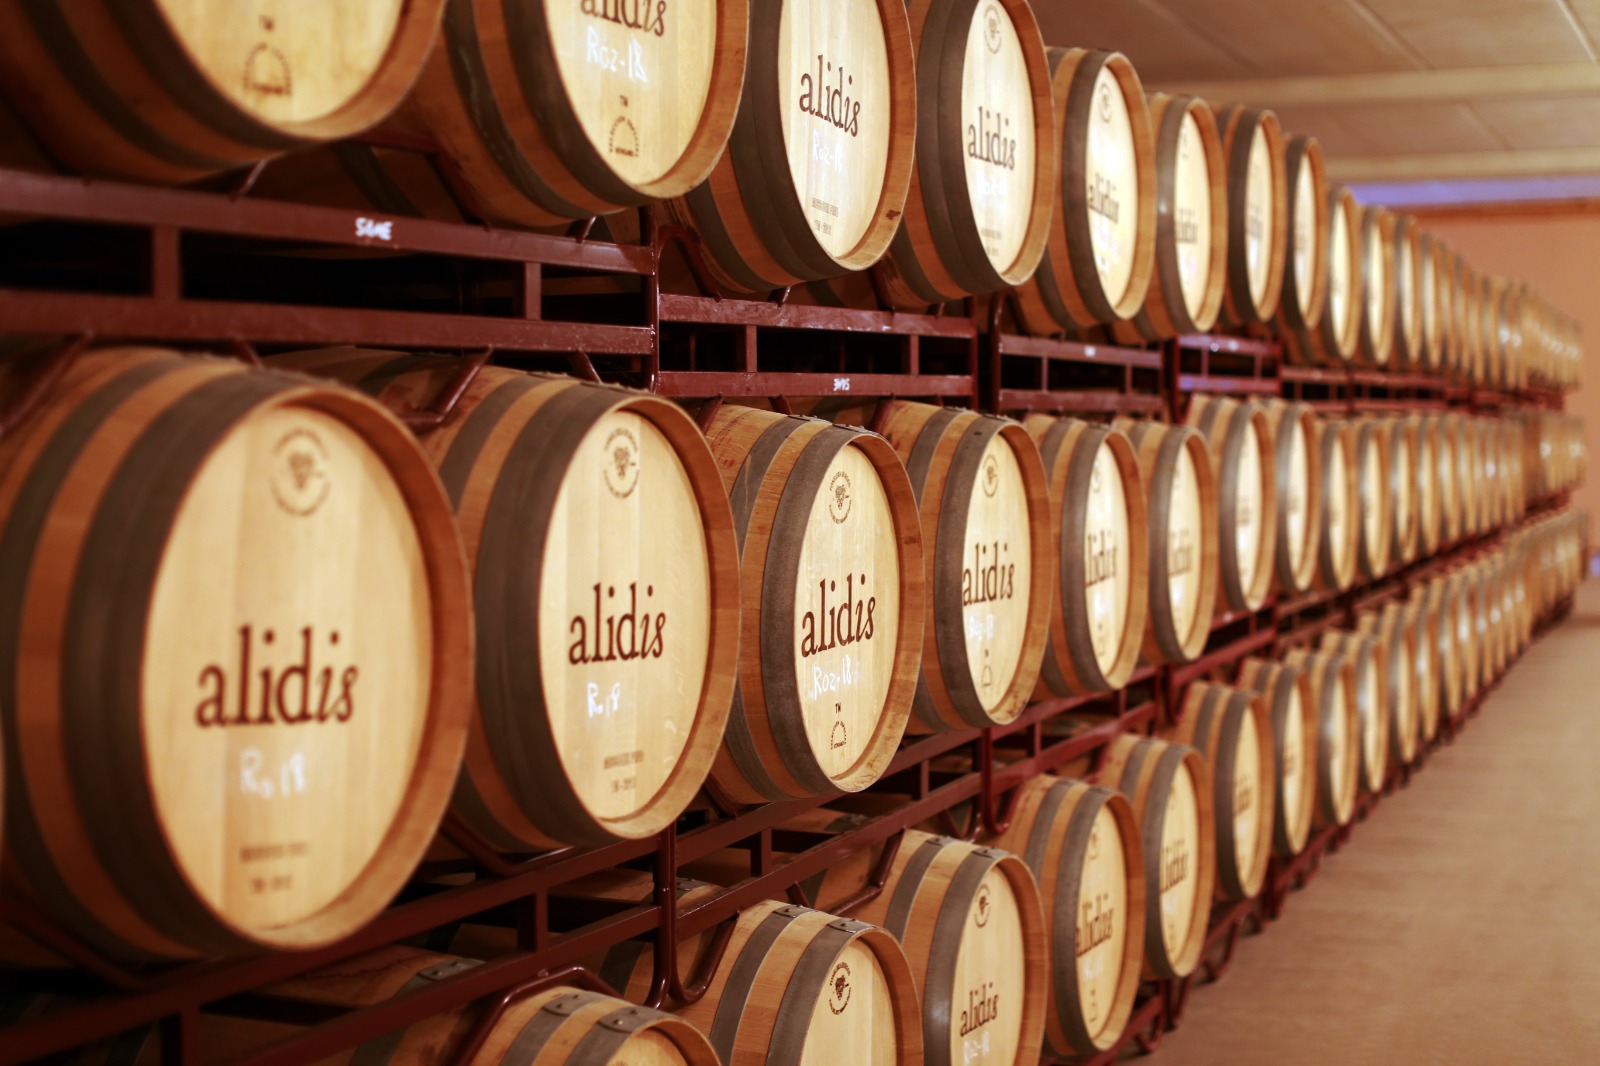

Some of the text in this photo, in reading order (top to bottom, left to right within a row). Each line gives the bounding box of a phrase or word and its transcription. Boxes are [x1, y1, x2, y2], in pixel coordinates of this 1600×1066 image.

[799, 54, 861, 138] alidis
[968, 106, 1016, 170] alidis
[801, 573, 876, 657] alidis
[963, 541, 1015, 606] alidis
[568, 582, 666, 665] alidis
[195, 623, 359, 727] alidis
[960, 982, 999, 1037] alidis
